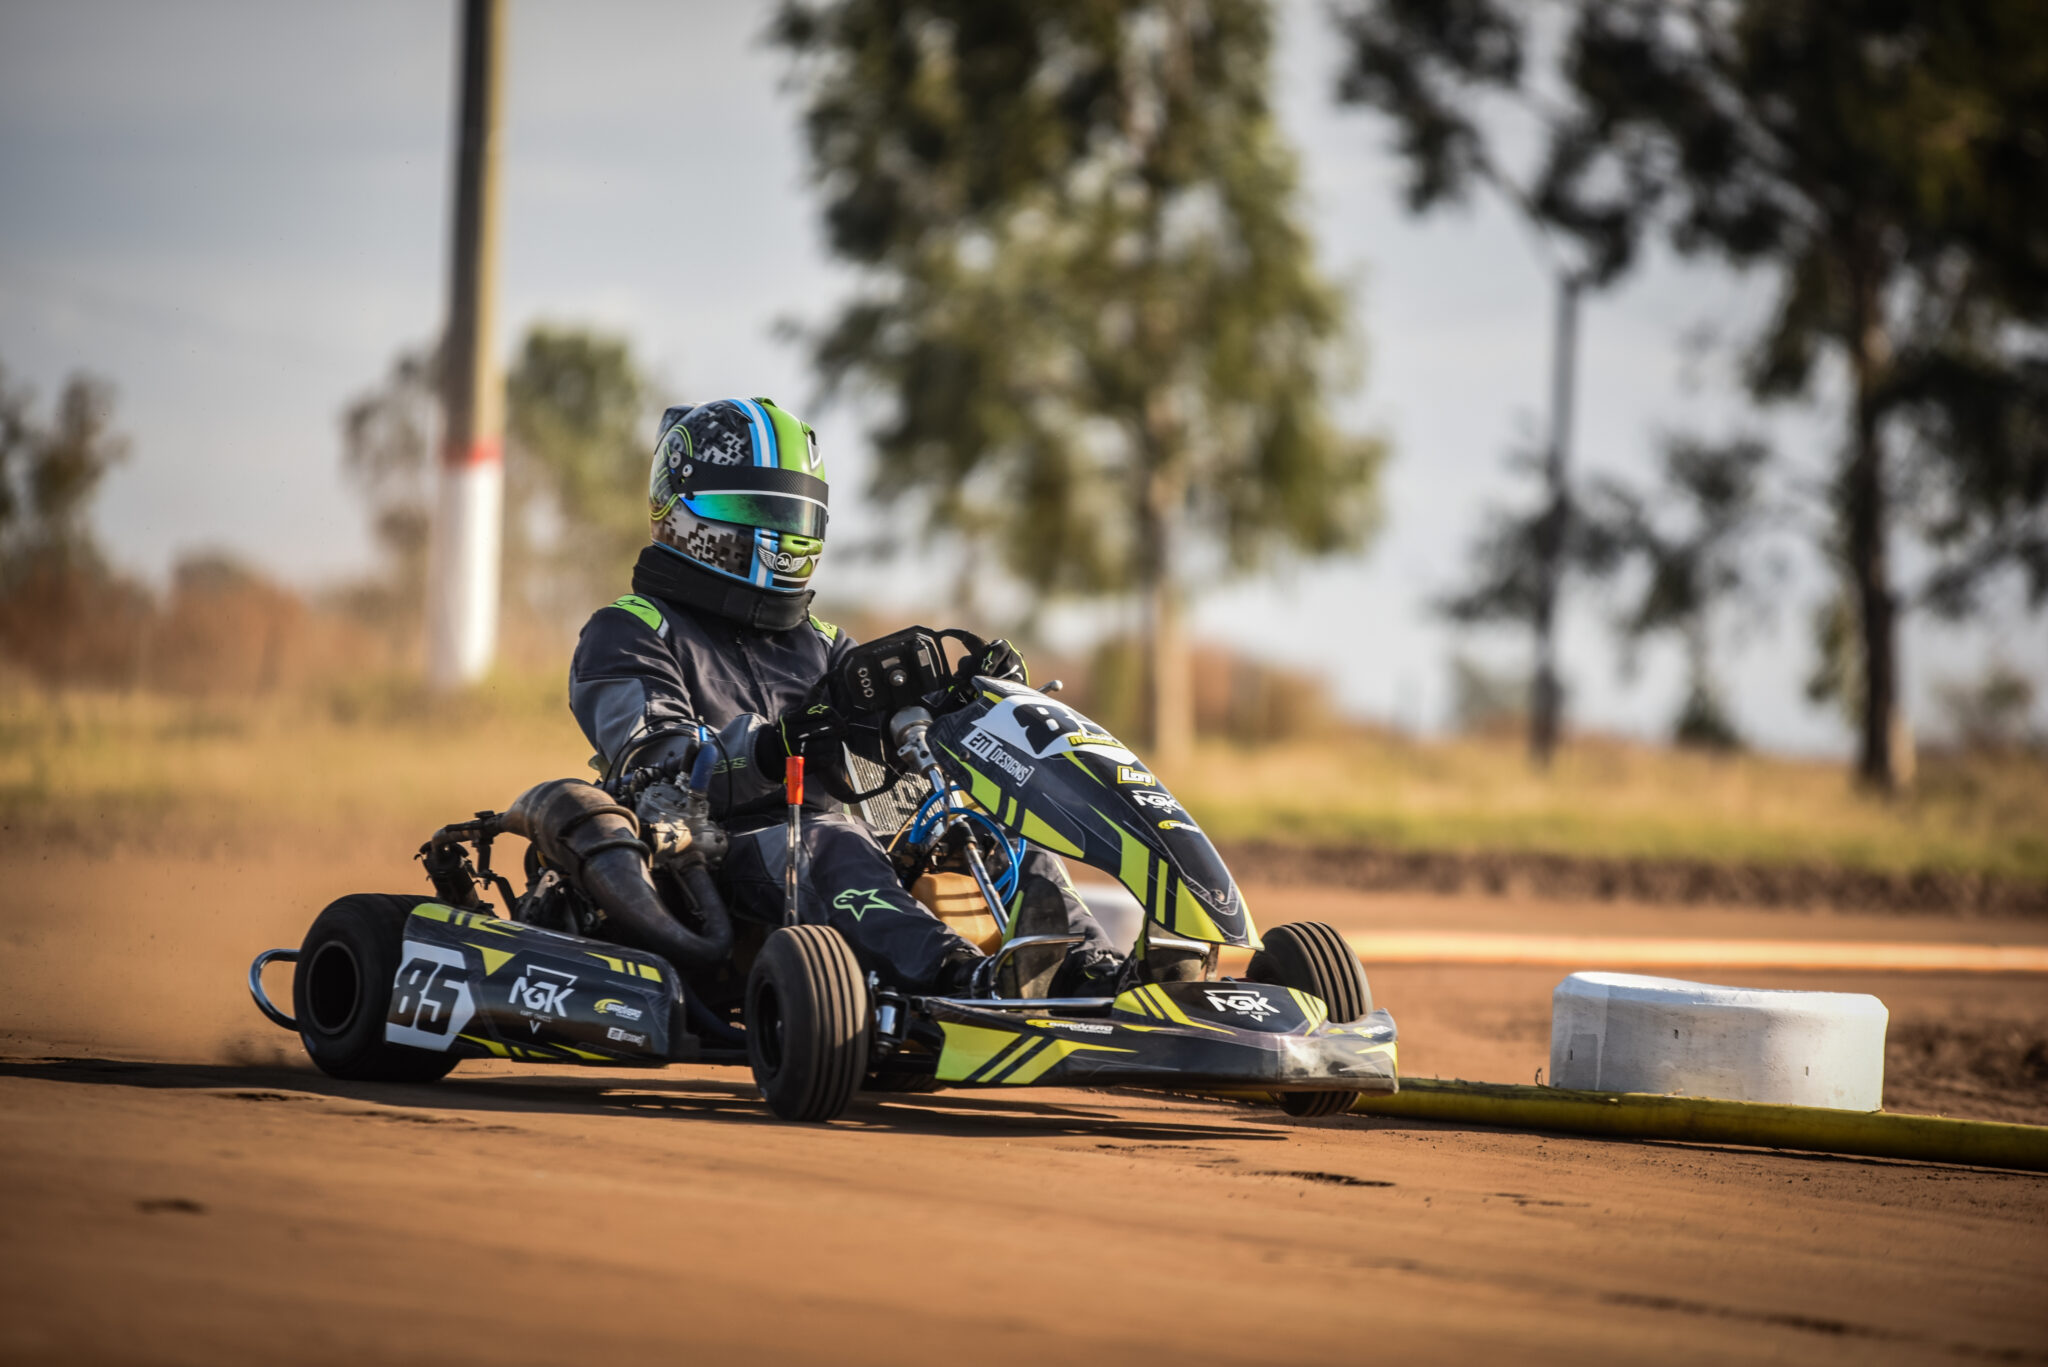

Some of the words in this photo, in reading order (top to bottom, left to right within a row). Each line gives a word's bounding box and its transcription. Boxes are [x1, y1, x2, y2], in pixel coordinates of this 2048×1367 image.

[989, 747, 1030, 782] DESIGNS
[386, 957, 467, 1036] 85
[508, 976, 575, 1018] NGK
[1206, 995, 1280, 1014] NGK
